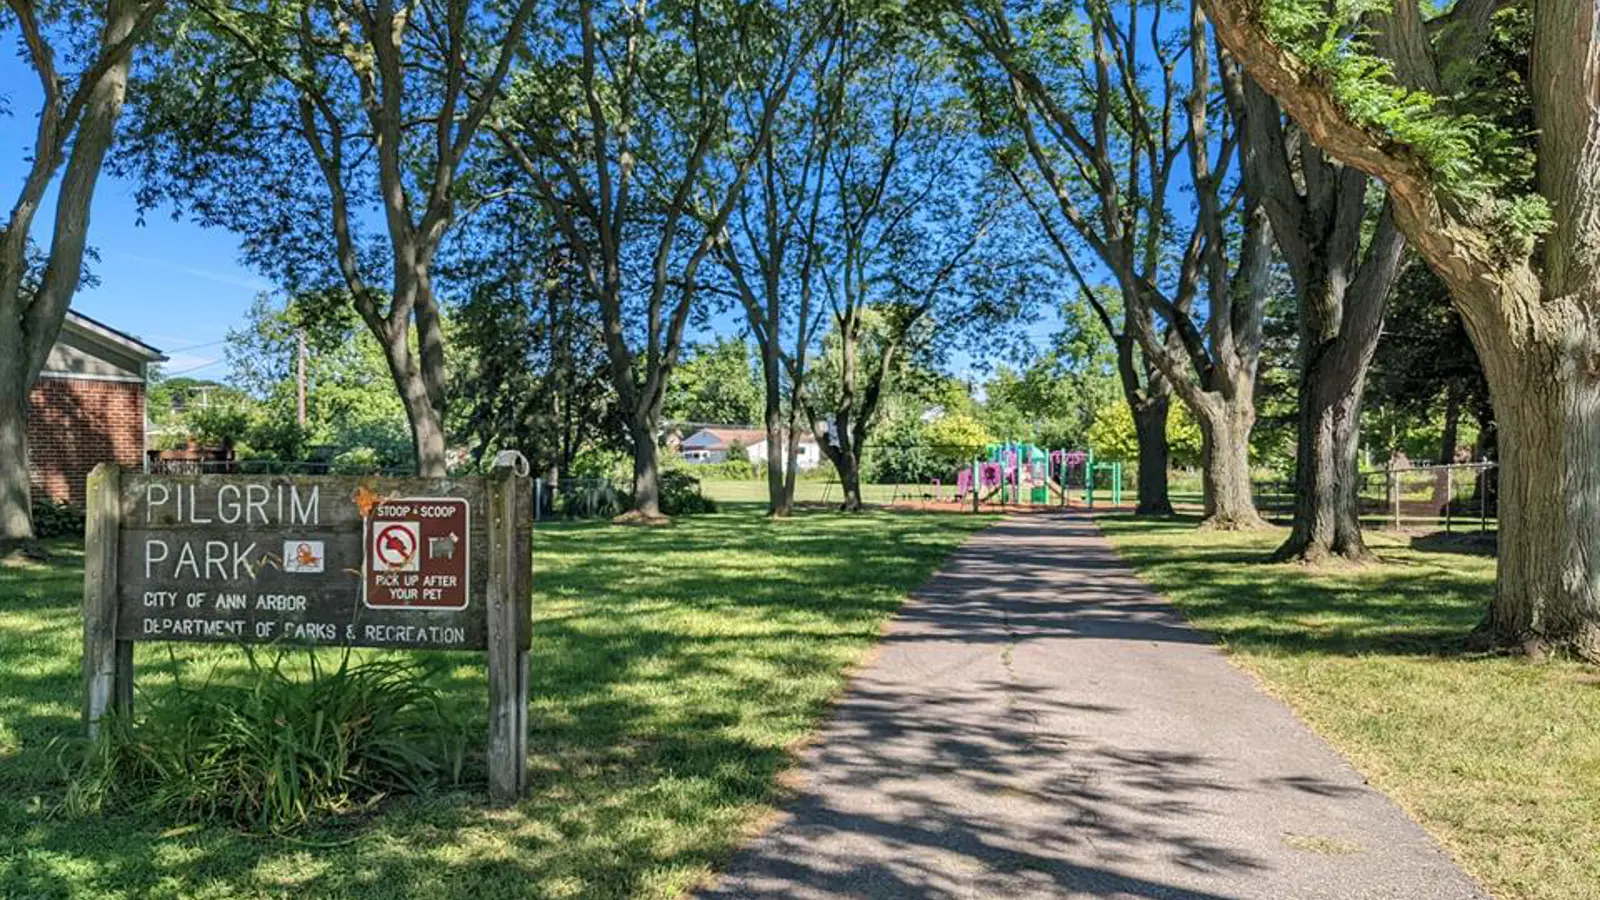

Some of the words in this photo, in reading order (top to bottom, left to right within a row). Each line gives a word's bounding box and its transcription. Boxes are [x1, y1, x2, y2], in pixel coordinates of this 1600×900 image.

[147, 484, 319, 524] PILGRIM
[377, 505, 410, 516] STOOP
[421, 505, 456, 517] SCOOP
[146, 540, 256, 579] PARK
[375, 574, 400, 586] PICK
[404, 575, 419, 586] UP
[422, 575, 457, 586] AFTER
[144, 592, 178, 607] CITY
[186, 593, 206, 608] OF
[215, 594, 247, 609] ANN
[255, 595, 306, 611] ARBOR
[389, 588, 418, 599] YOUR
[422, 588, 442, 599] PET
[144, 618, 246, 636] DEPARTMENT
[256, 622, 275, 637] OF
[346, 624, 356, 640] &
[365, 625, 465, 643] RECREATION
